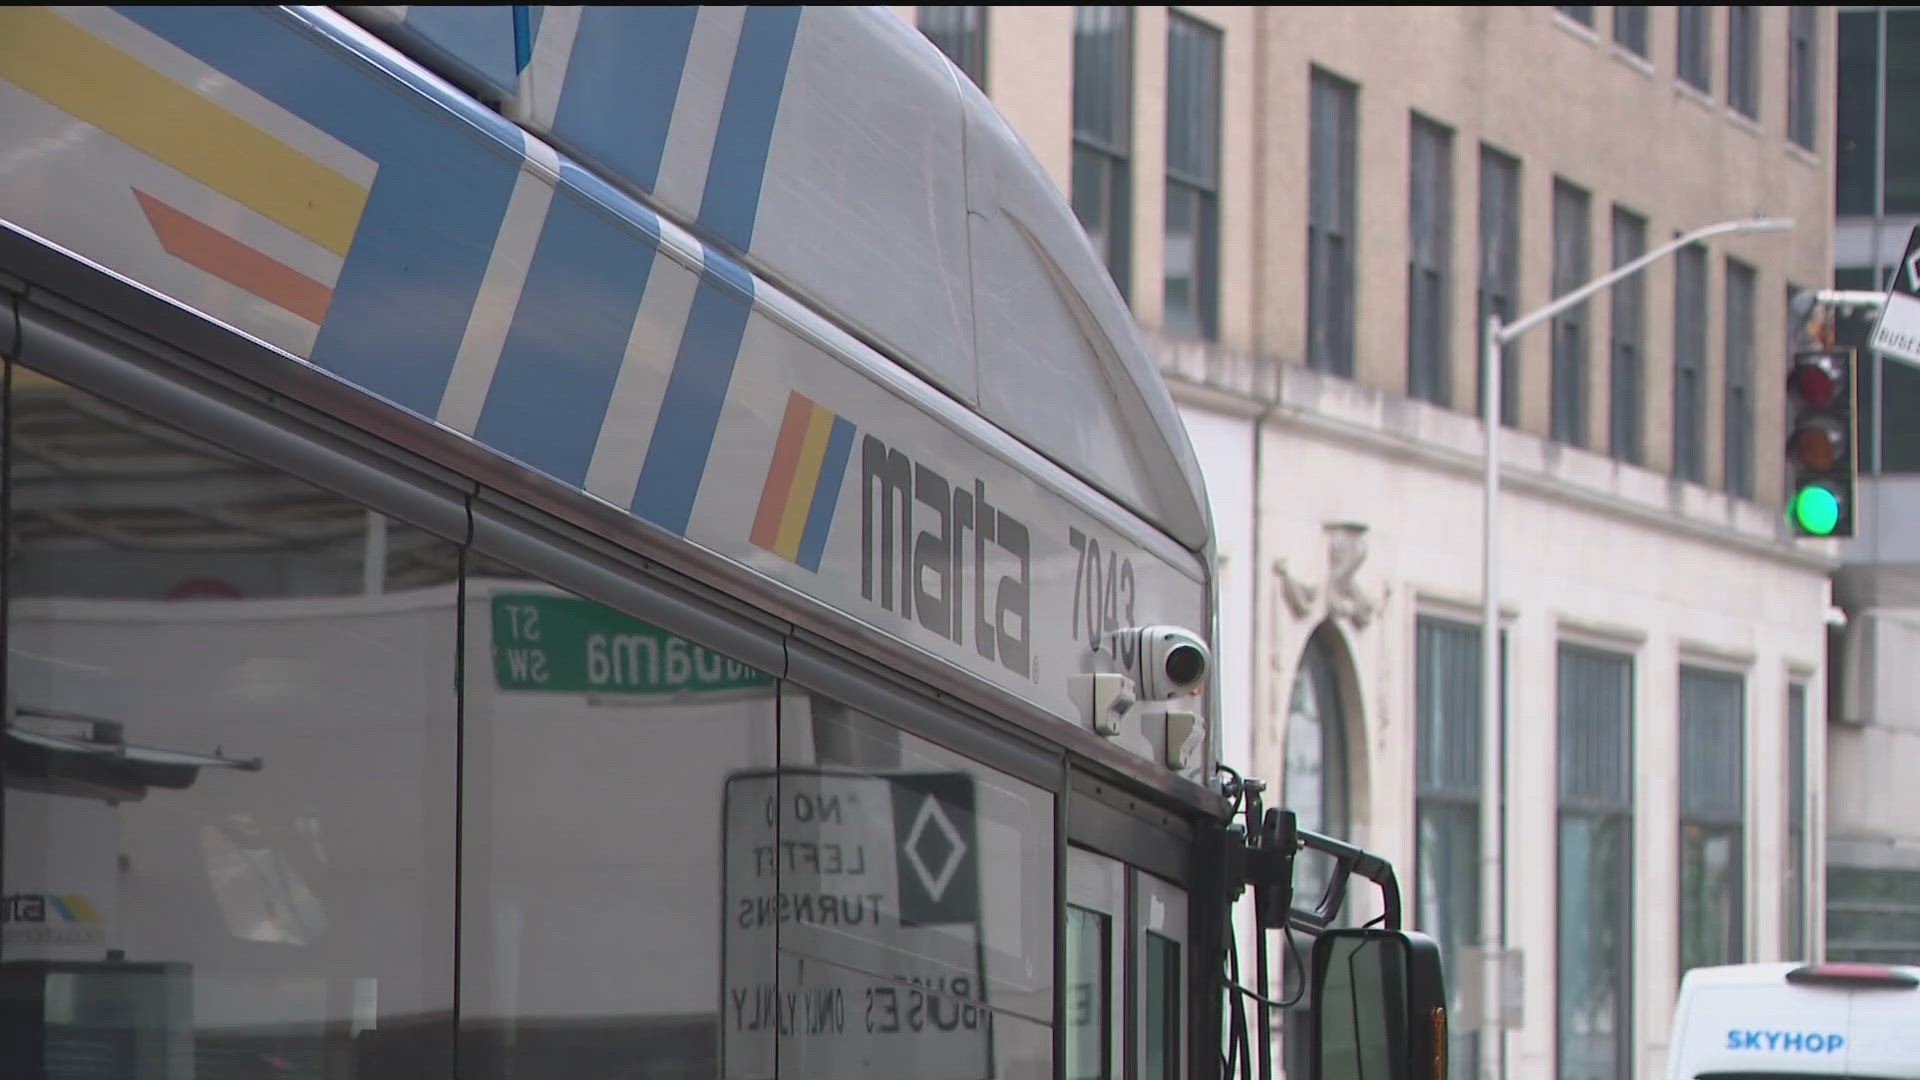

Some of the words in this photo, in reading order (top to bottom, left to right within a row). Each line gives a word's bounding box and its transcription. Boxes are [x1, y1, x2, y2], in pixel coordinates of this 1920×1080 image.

[861, 432, 1030, 679] marta
[1069, 526, 1136, 671] 7043
[1727, 1030, 1845, 1053] SKYHOP
